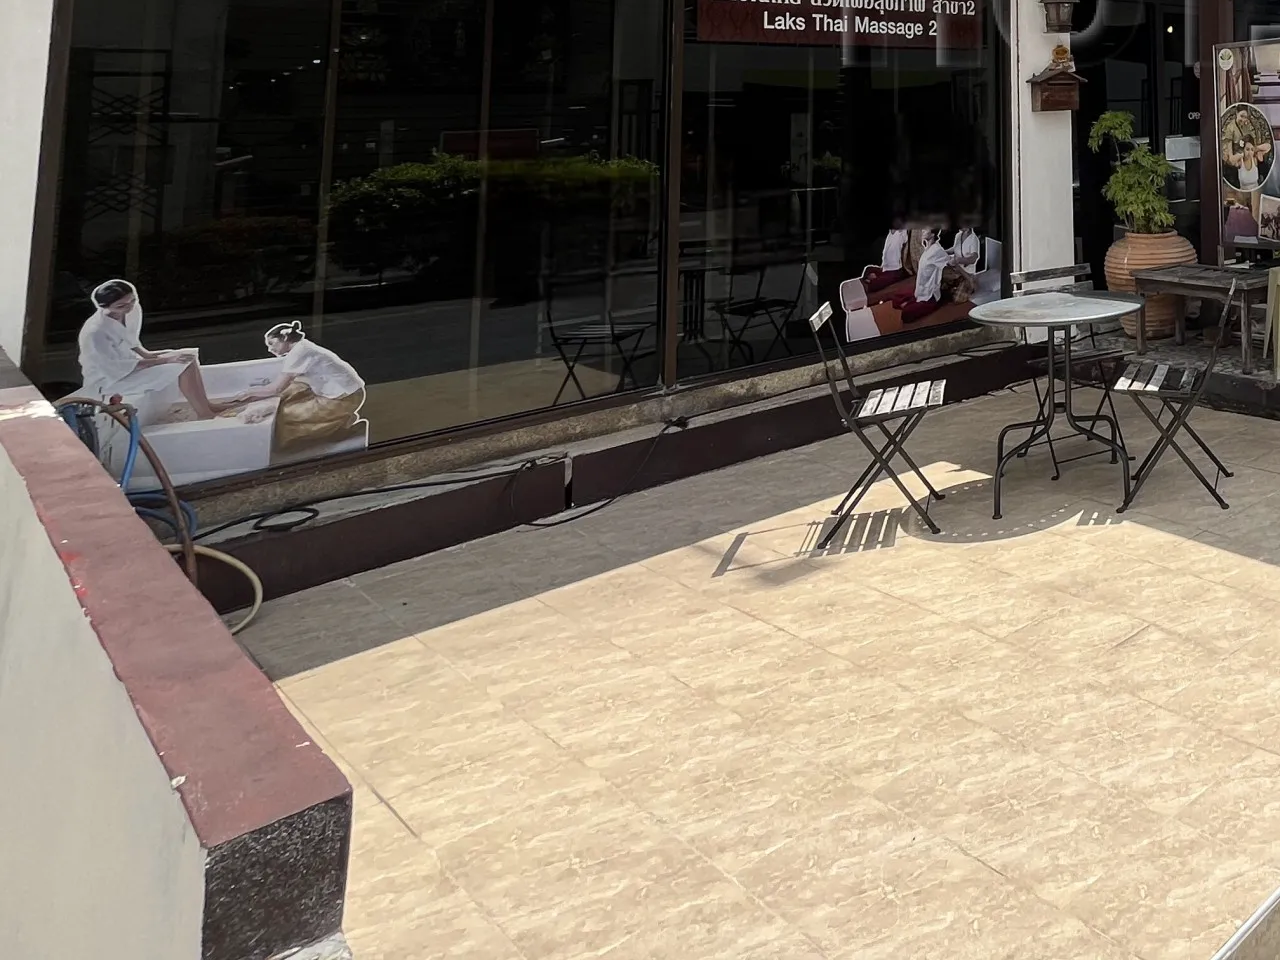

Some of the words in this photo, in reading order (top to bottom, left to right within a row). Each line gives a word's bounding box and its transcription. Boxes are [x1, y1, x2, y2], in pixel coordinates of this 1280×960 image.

[933, 0, 976, 16] สาขา2
[763, 12, 806, 31] Laks
[812, 14, 848, 32] Thai
[855, 16, 923, 39] Massage
[928, 20, 937, 35] 2
